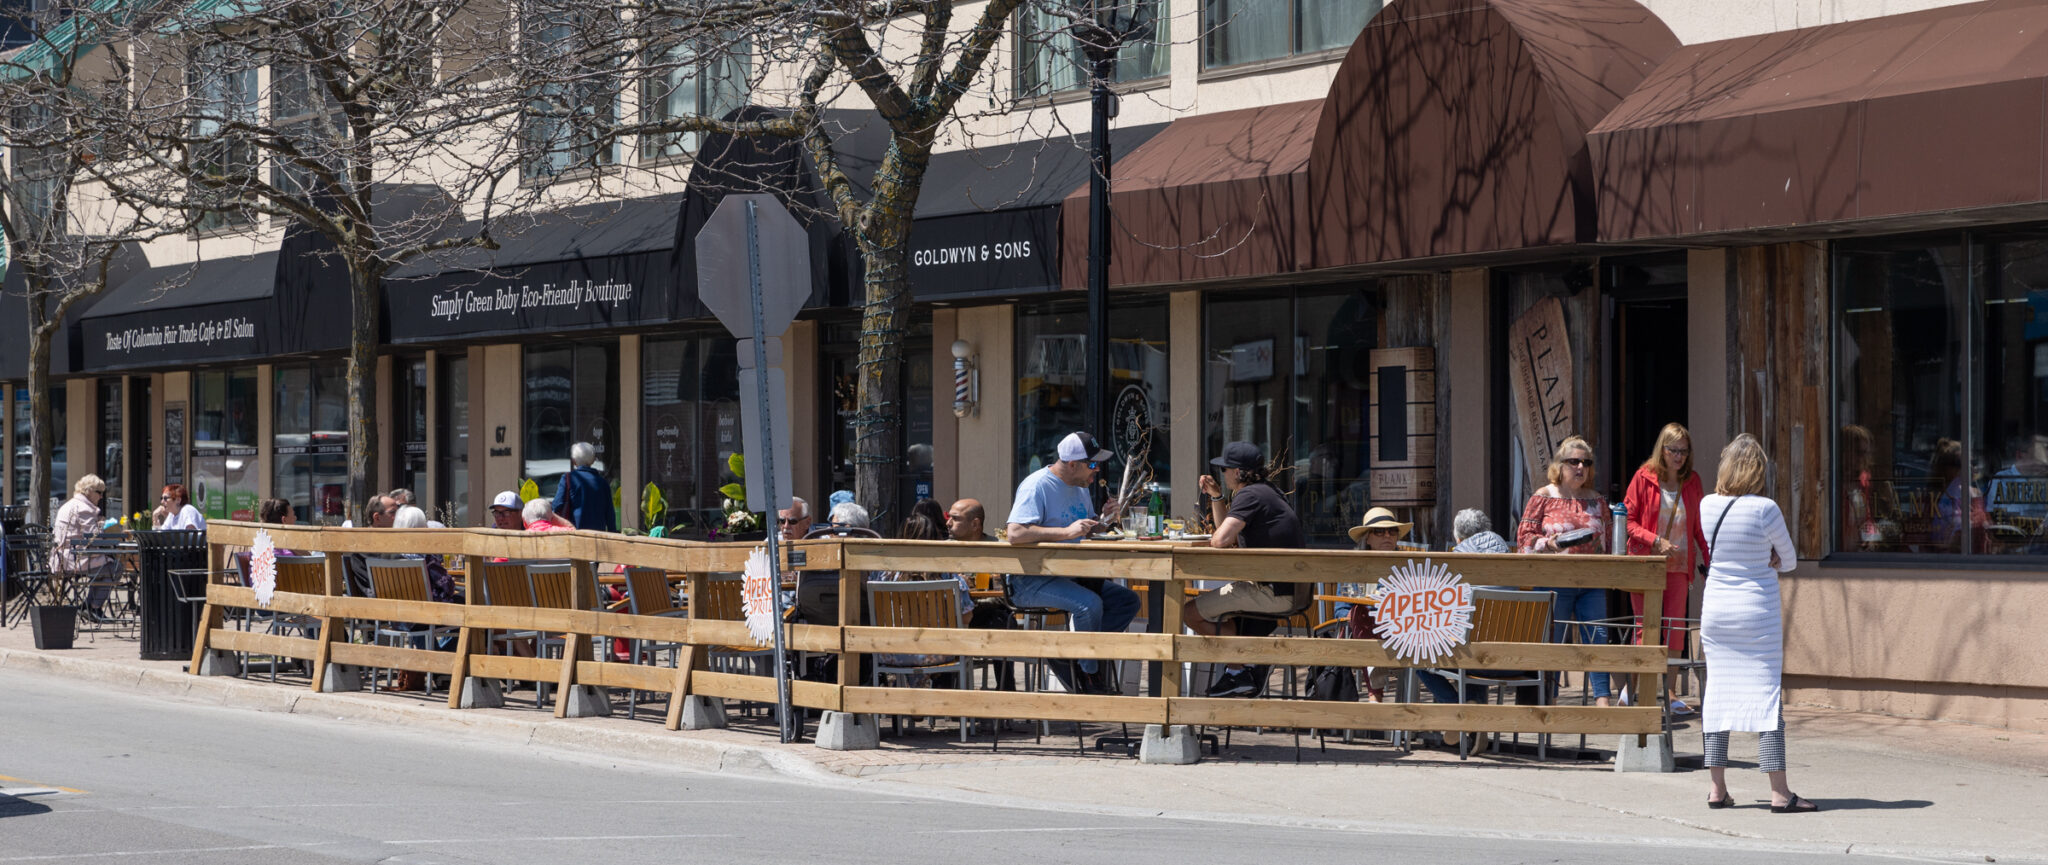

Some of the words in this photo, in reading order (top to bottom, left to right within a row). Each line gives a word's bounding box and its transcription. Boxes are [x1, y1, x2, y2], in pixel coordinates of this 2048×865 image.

[914, 245, 976, 266] GOLDWYN
[980, 244, 990, 261] &
[994, 240, 1031, 260] SONS
[431, 291, 464, 321] Simply
[465, 290, 493, 313] Green
[495, 286, 520, 315] Baby
[521, 280, 583, 310] Eco-Friendly
[585, 278, 632, 307] Boutique
[106, 332, 122, 351] Taste
[123, 329, 132, 354] Of
[132, 326, 163, 348] Colombia
[163, 325, 177, 345] Fair
[178, 322, 198, 343] Trade
[199, 320, 215, 346] Cafe
[216, 321, 223, 339] &
[223, 318, 232, 339] El
[233, 317, 255, 338] Salon
[496, 426, 506, 443] 67
[1521, 365, 1536, 410] INSPIRED
[1530, 410, 1543, 446] RESTO
[1538, 448, 1548, 473] BAR
[916, 484, 929, 495] OPEN
[744, 576, 772, 601] APERO
[1377, 586, 1468, 622] APEROL
